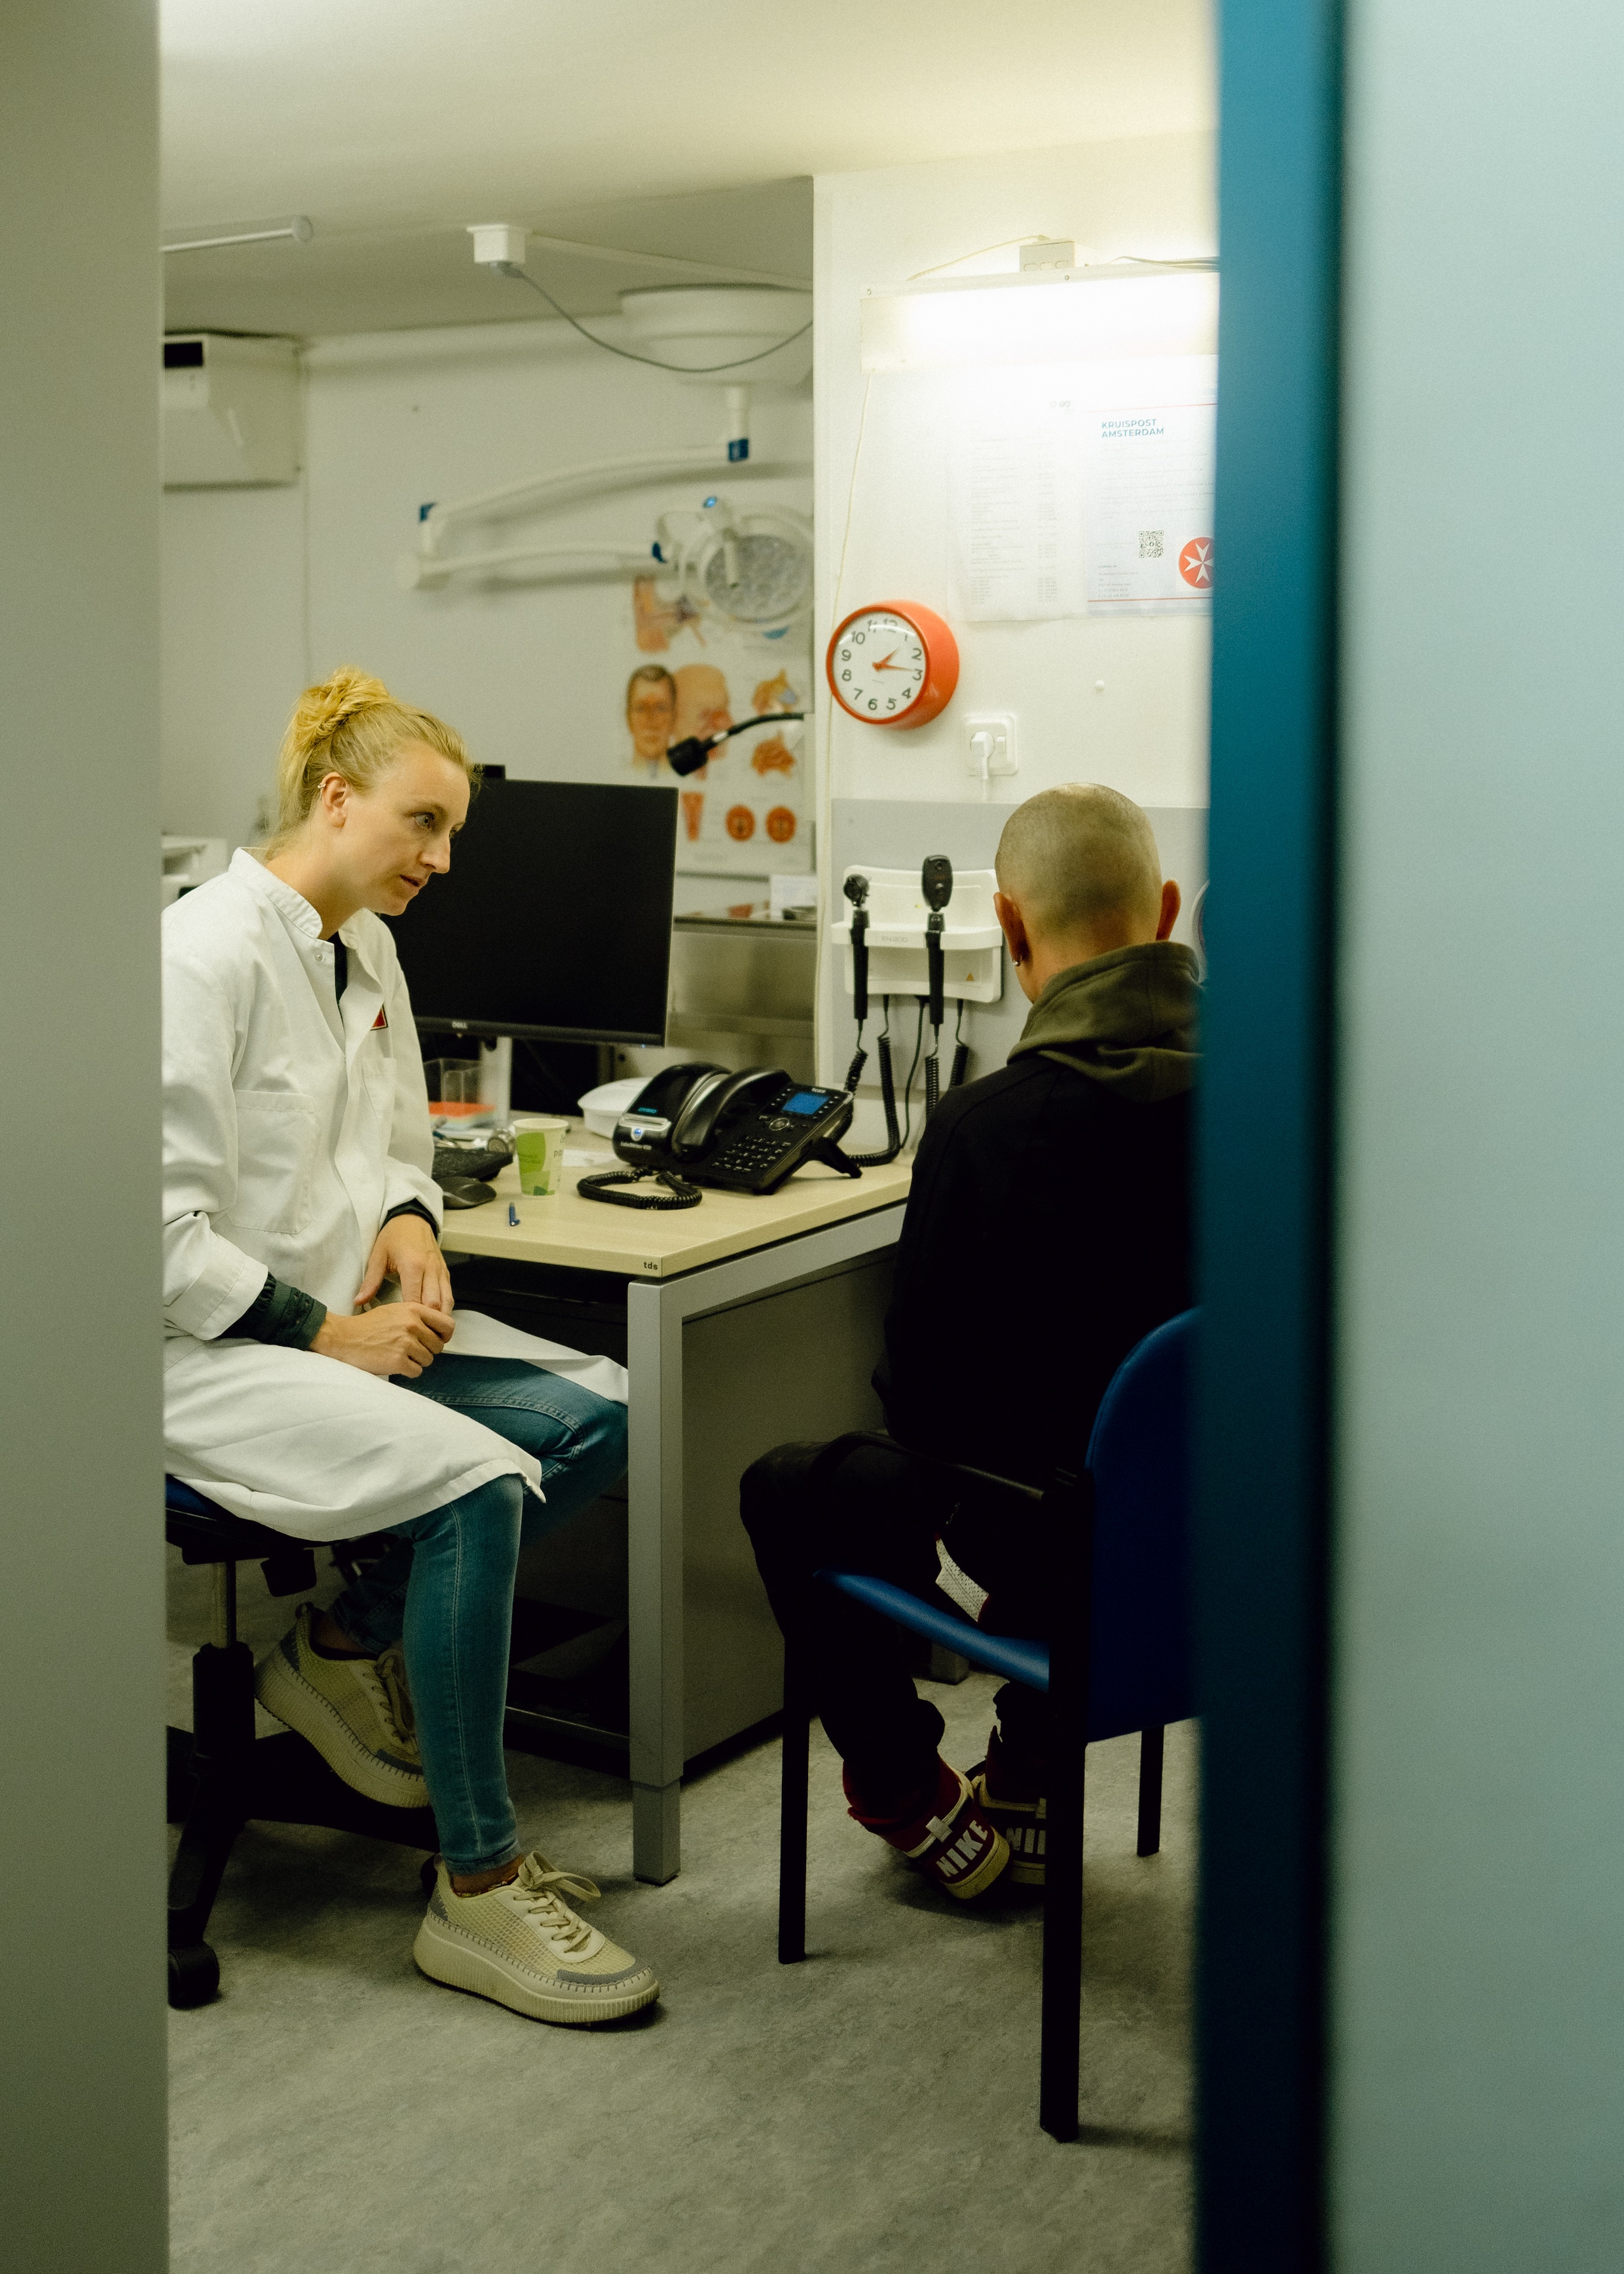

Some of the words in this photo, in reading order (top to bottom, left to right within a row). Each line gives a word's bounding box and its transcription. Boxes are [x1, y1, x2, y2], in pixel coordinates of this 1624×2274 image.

[1101, 419, 1156, 429] KRUISPOST
[1101, 428, 1164, 438] AMSTERDAM
[883, 618, 898, 633] 12
[851, 631, 866, 644] 10
[841, 649, 851, 662] 9
[912, 648, 922, 660] 2
[841, 669, 851, 681] 8
[912, 668, 923, 681] 3
[853, 688, 863, 700] 7
[901, 687, 912, 699] 4
[868, 698, 877, 711] 6
[886, 698, 897, 710] 5
[644, 1261, 658, 1270] tds
[1006, 1827, 1046, 1855] NI
[936, 1819, 987, 1878] NIKE
